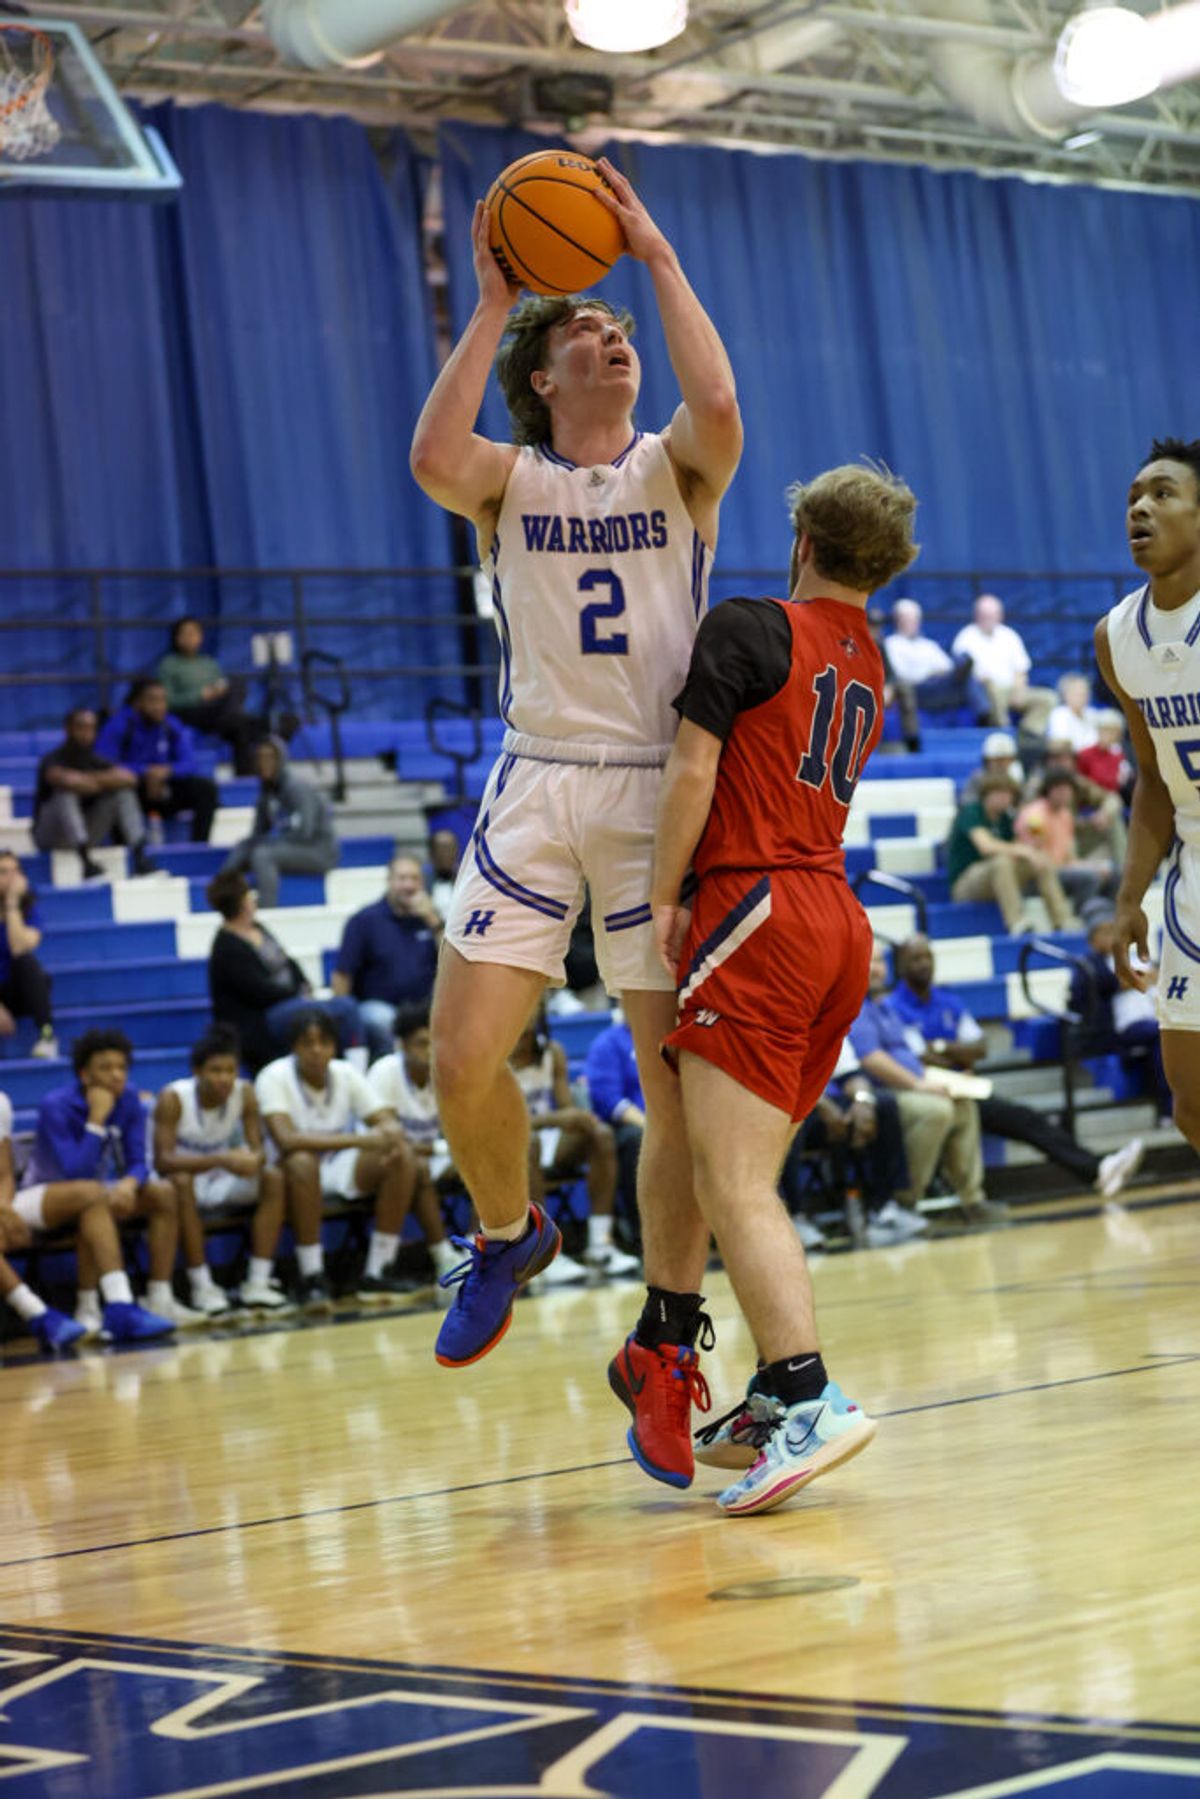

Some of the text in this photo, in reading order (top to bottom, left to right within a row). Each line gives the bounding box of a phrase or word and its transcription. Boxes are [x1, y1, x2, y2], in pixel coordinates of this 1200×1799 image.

[521, 510, 668, 553] WARRIORS
[577, 568, 629, 656] 2
[1134, 692, 1200, 729] ARRI
[796, 663, 878, 807] 10
[463, 909, 496, 937] H
[1166, 975, 1189, 1001] H
